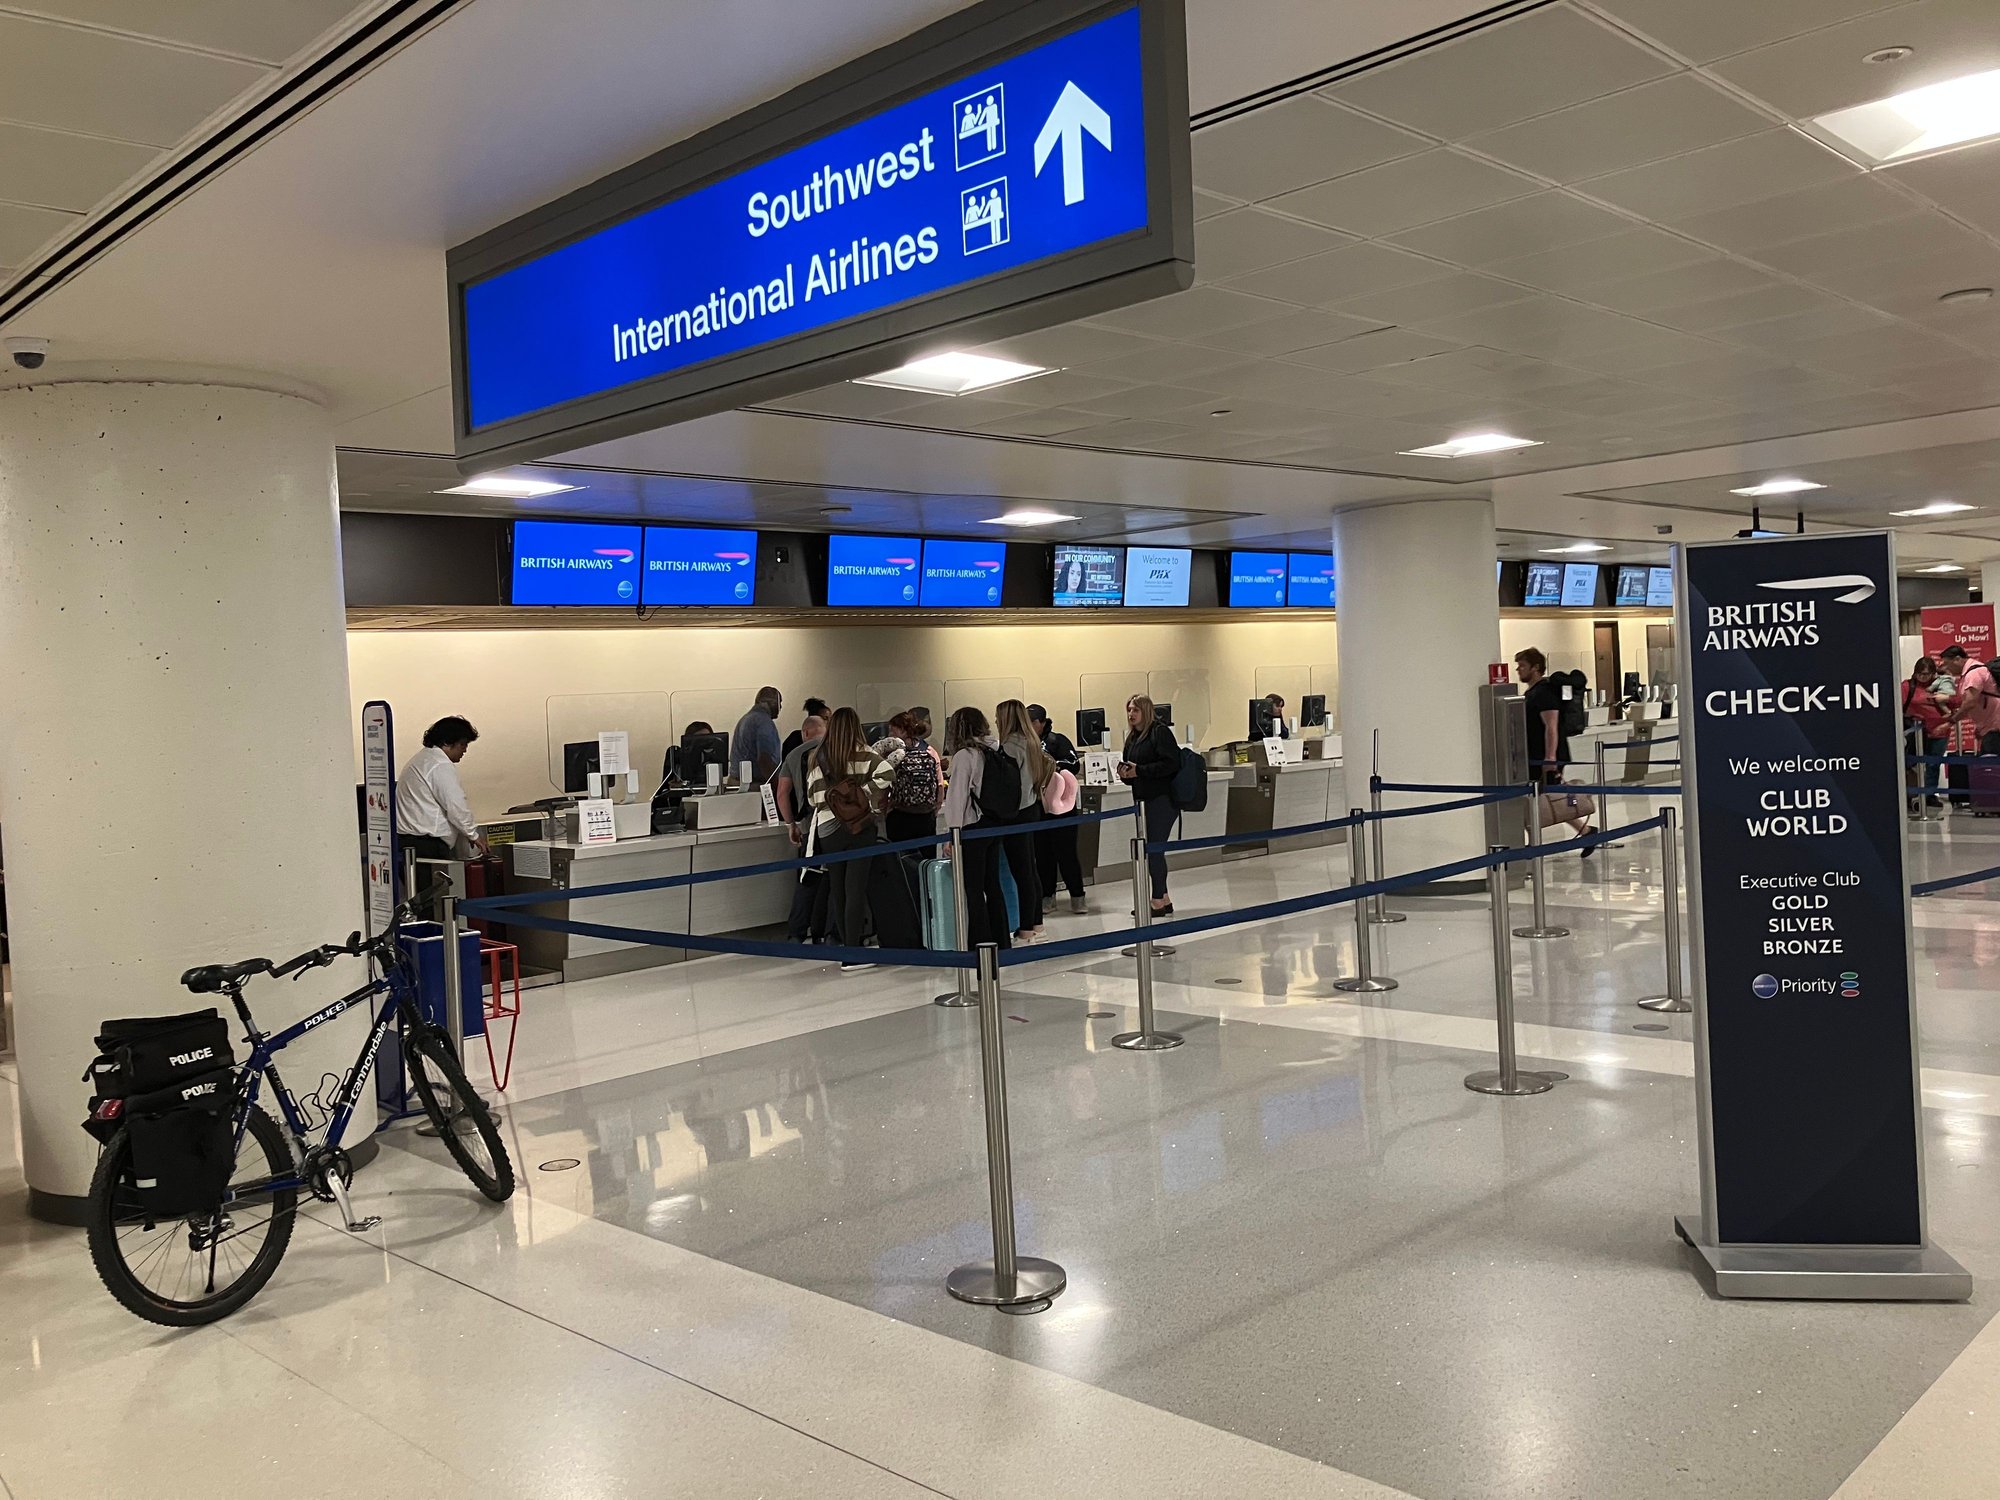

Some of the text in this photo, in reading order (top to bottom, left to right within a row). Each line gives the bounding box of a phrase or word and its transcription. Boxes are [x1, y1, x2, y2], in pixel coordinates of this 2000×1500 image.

[747, 127, 935, 238] Southwest
[613, 226, 939, 363] International Airlines
[520, 557, 613, 570] BRITISH AIRWAYS
[649, 560, 731, 572] BRITISH AIRWAYS
[1064, 553, 1116, 564] IN OUR COMMUNITY
[1142, 554, 1179, 565] Welcome to
[833, 565, 900, 576] BRITISH AIRWAYS
[926, 568, 986, 578] BRITISH AIRWAYS
[1149, 569, 1171, 579] PHX
[1233, 575, 1275, 584] BRITISH AIRWAYS
[1707, 600, 1816, 627] BRITISH
[1960, 624, 1989, 633] Charge
[1703, 624, 1820, 651] AIRWAYS
[1954, 633, 1989, 644] Up Now!
[1705, 682, 1880, 717] CHECK-IN
[1728, 754, 1861, 775] We welcome
[1760, 788, 1831, 811] CLUB
[488, 825, 513, 833] CAUTION
[1746, 814, 1848, 837] WORLD
[1740, 871, 1861, 889] Executive Club
[1771, 895, 1829, 911] GOLD
[1768, 917, 1835, 933] SILVER
[1763, 939, 1843, 955] BRONZE
[1781, 978, 1837, 995] Priority
[304, 1002, 344, 1030] POLICE
[169, 1046, 214, 1067] POLICE
[350, 1021, 388, 1099] cannondale
